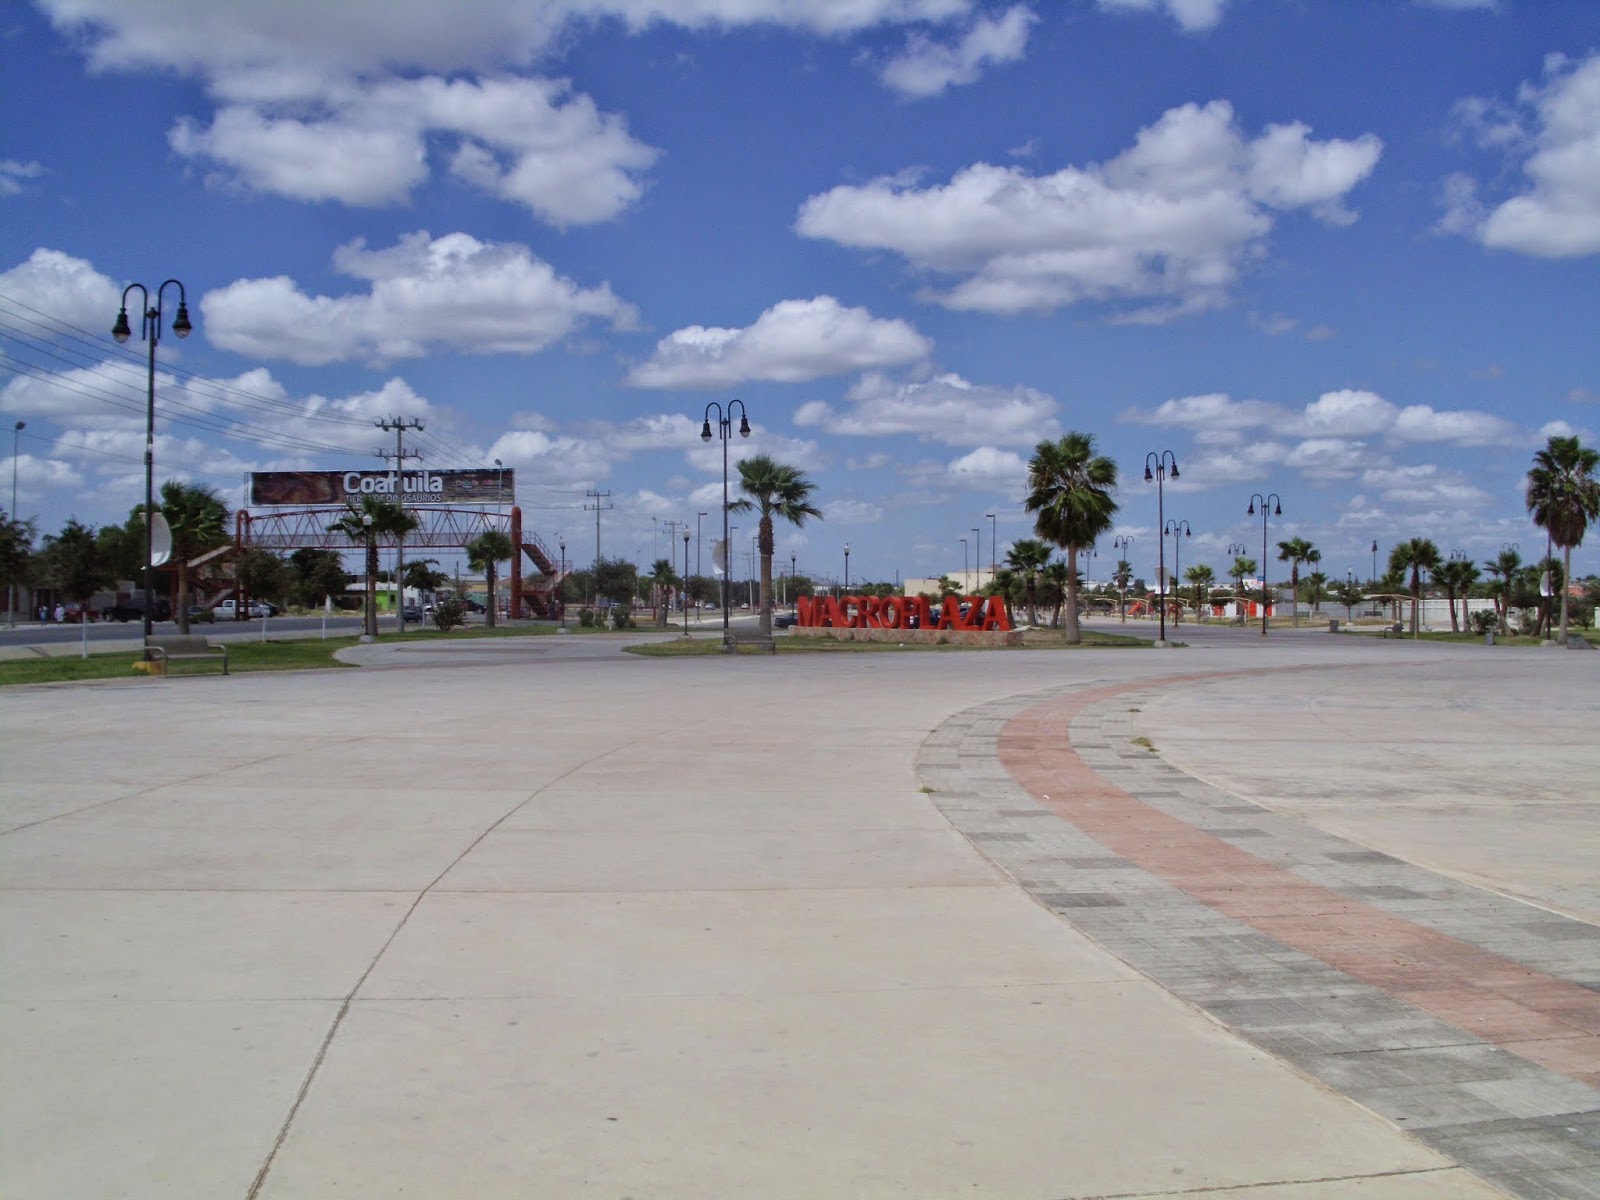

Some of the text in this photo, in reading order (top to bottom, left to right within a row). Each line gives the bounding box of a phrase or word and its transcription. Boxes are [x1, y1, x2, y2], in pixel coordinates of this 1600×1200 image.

[343, 471, 443, 494] Coahuila
[346, 495, 372, 503] TIER
[387, 493, 441, 502] DINOSAURIOS
[797, 596, 1012, 632] MACROPLAZA
